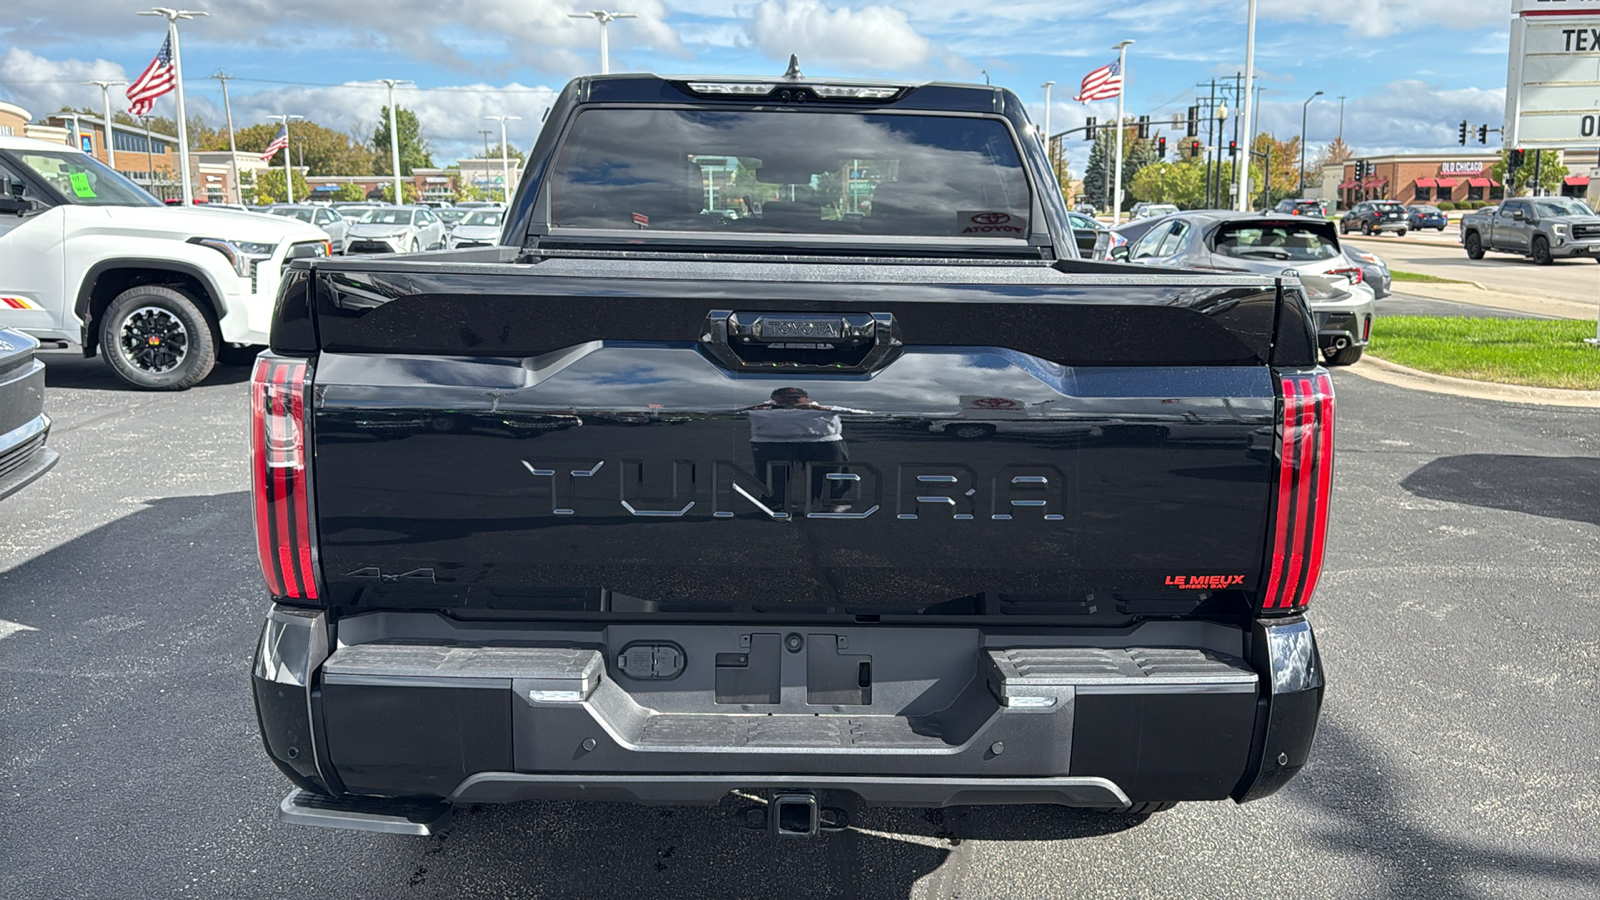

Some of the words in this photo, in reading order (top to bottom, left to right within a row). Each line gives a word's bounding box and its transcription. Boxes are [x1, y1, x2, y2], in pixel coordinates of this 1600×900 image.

[1442, 162, 1455, 172] OLD
[1456, 162, 1483, 172] CHICAGO
[768, 321, 835, 335] TOYOTA
[520, 457, 1067, 521] TUNDRA
[1165, 575, 1187, 585] LE
[1190, 575, 1245, 585] MIEUX
